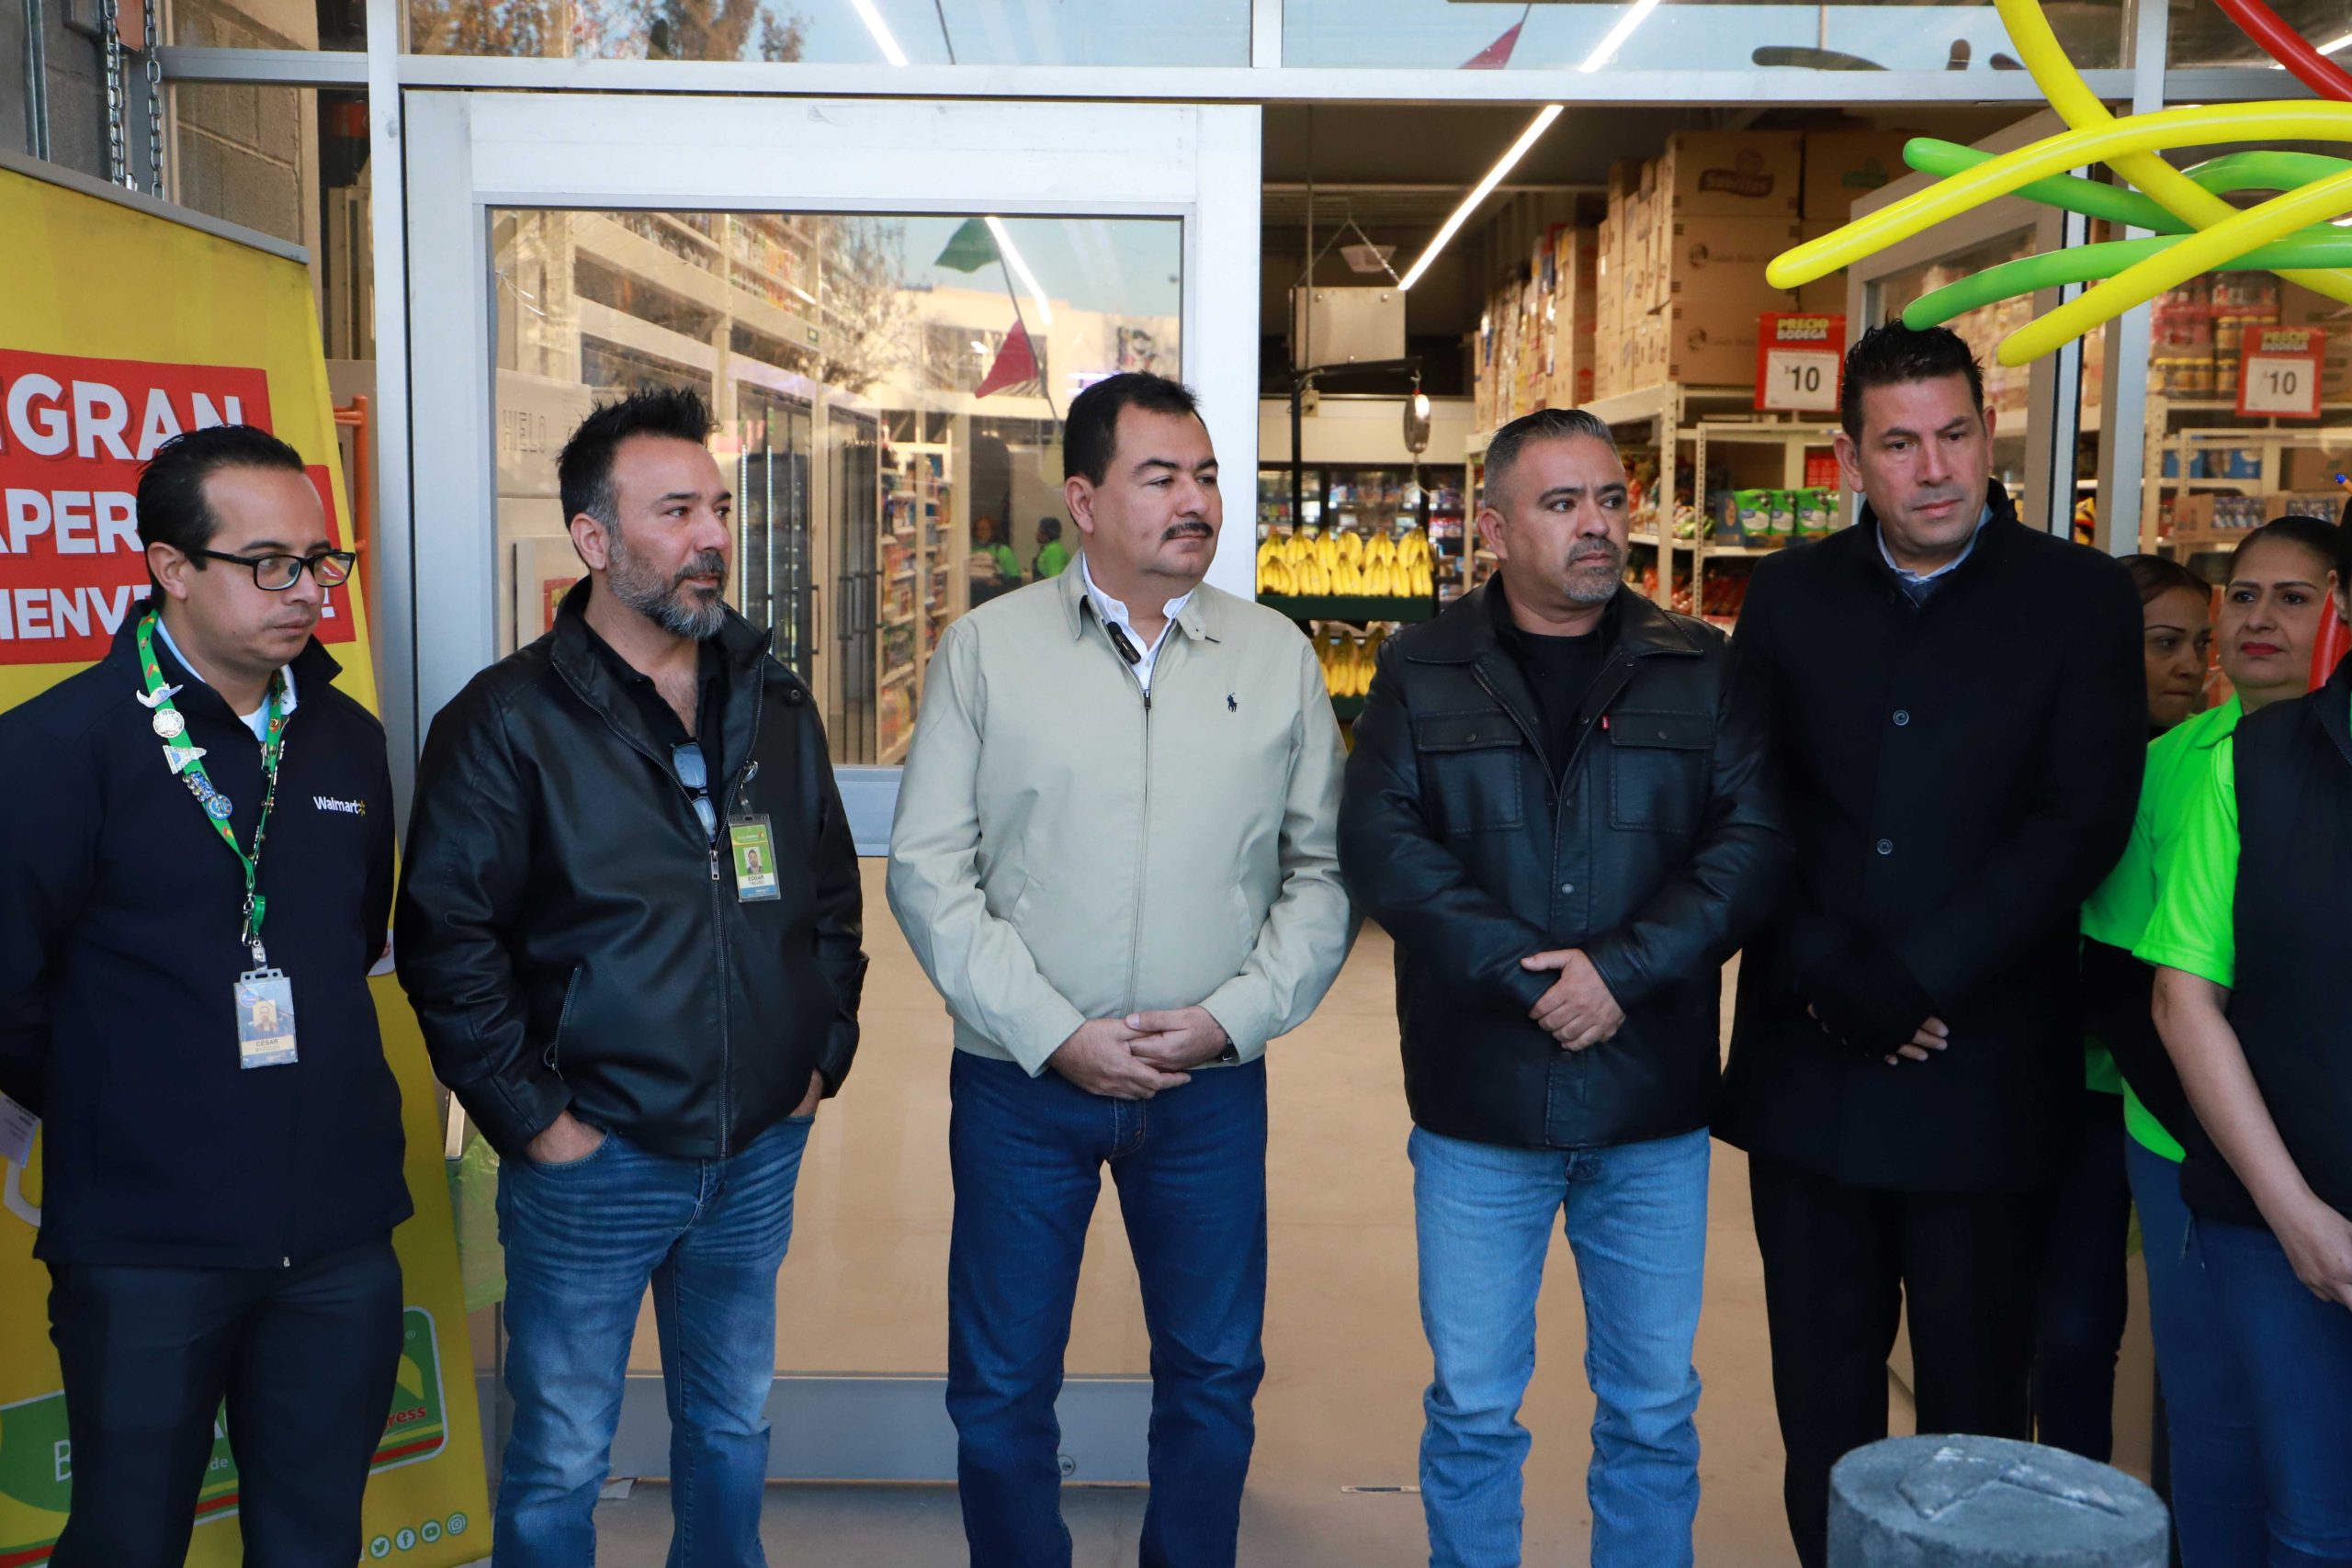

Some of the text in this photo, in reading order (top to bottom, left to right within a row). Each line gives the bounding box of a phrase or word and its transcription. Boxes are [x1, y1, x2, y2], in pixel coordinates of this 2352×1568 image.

[1778, 318, 1829, 331] PRECIO
[1777, 329, 1827, 340] BODEGA
[0, 373, 244, 461] GRAN
[313, 795, 359, 814] Walmart
[386, 1406, 426, 1429] ress
